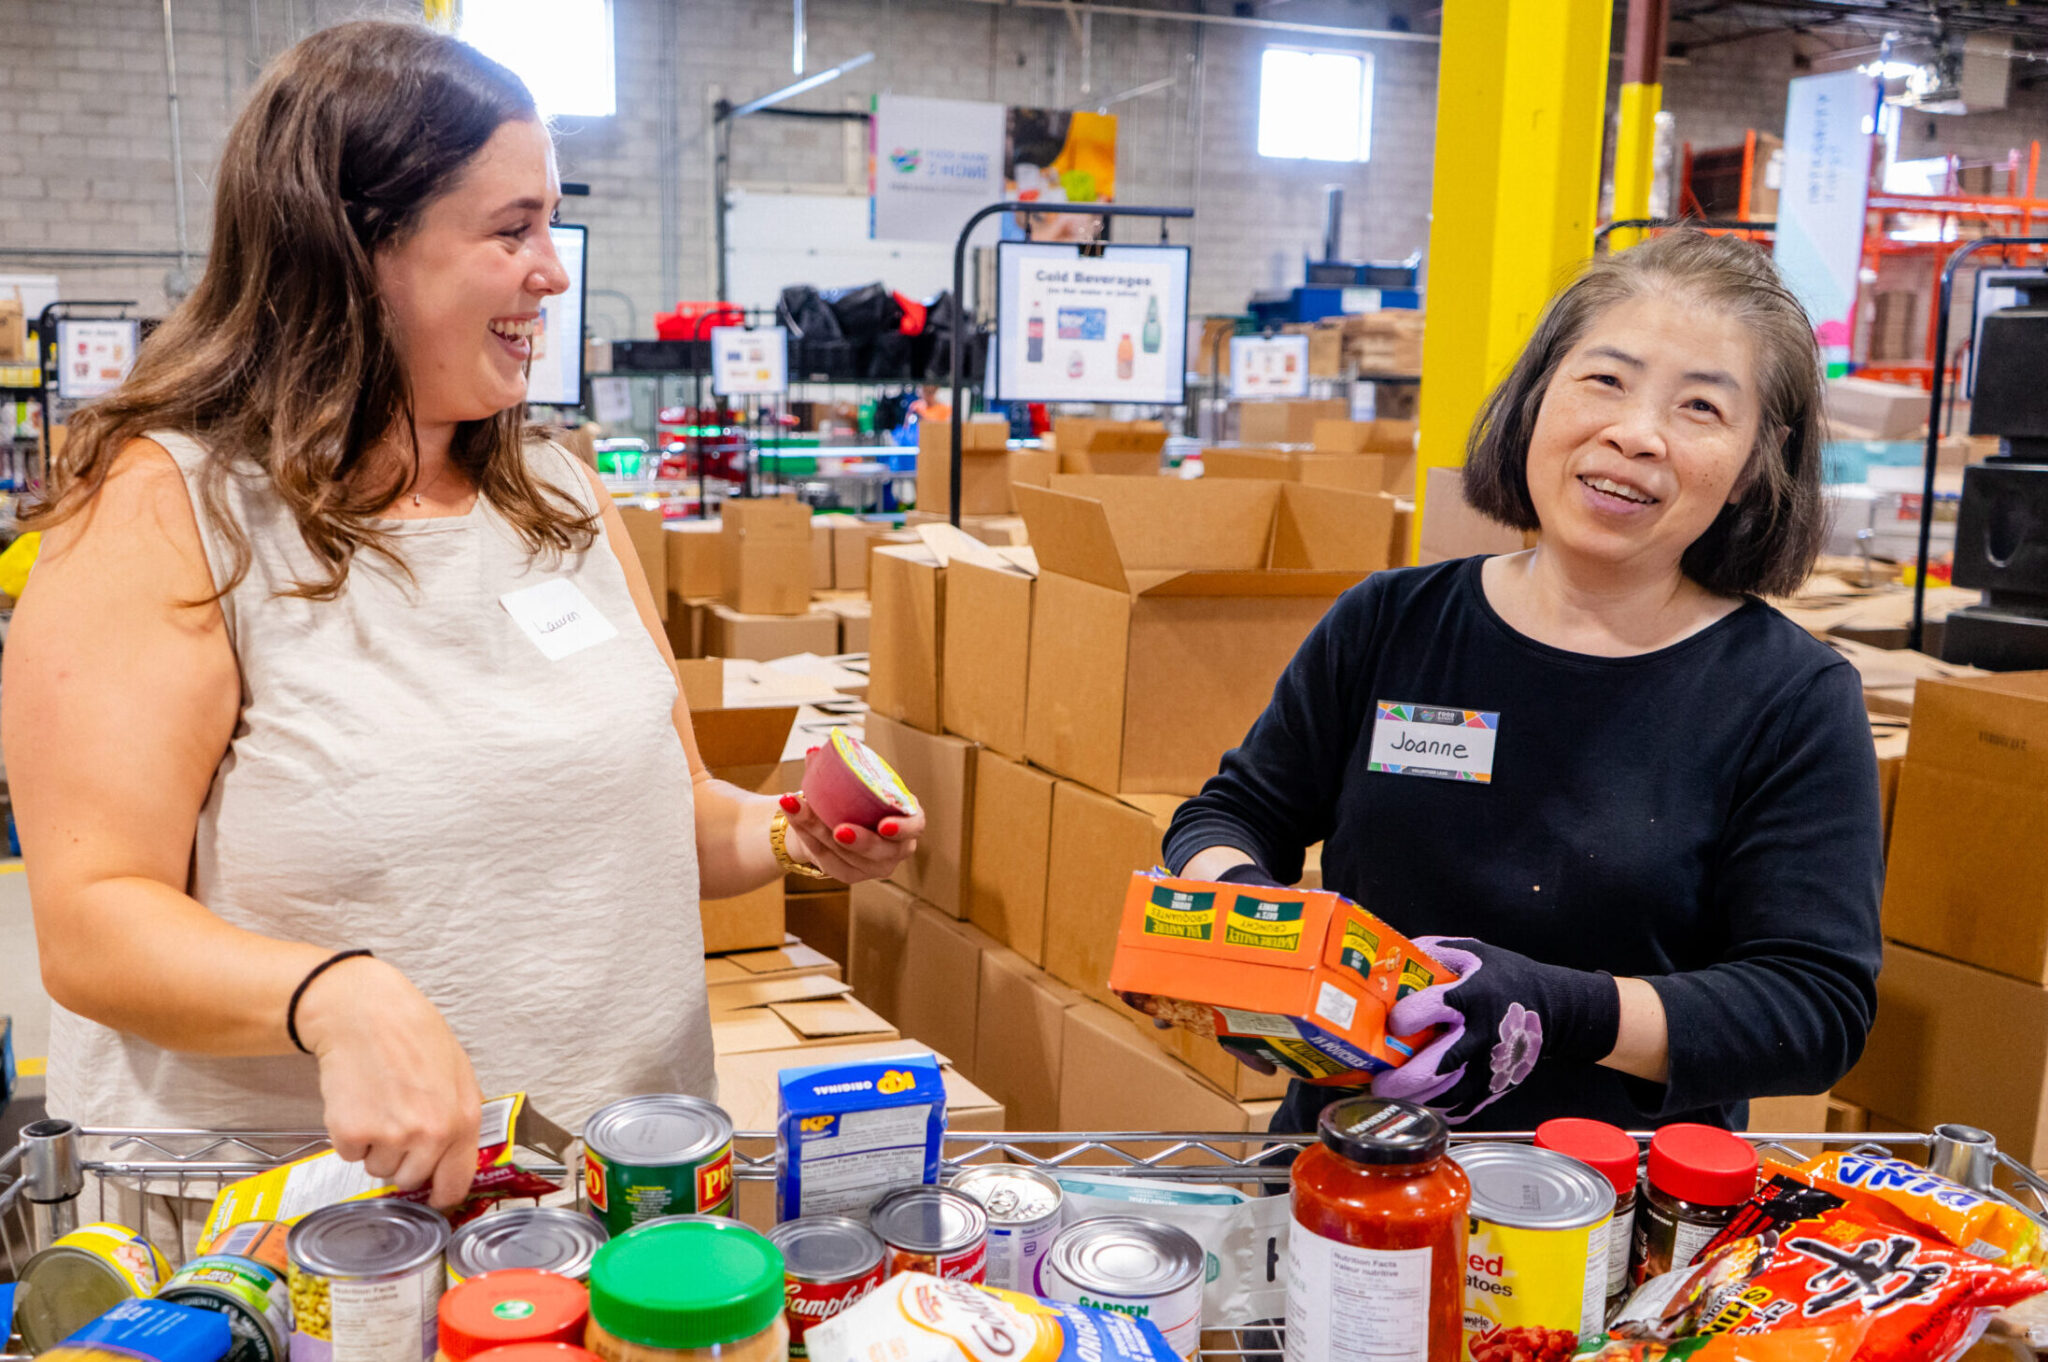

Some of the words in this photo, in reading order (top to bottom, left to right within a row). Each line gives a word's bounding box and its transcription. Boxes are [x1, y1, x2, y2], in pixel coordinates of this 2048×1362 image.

[1036, 270, 1068, 282] Cold
[1074, 272, 1151, 287] Beverages
[1390, 731, 1469, 759] Joanne
[1151, 908, 1208, 924] CROQUANTES
[1240, 920, 1286, 933] CRUNCHY
[1227, 929, 1259, 947] VALLEY
[1260, 935, 1297, 950] NATURE
[813, 1080, 873, 1096] ORIGINAL
[1334, 1252, 1370, 1266] Nutrition
[1373, 1260, 1397, 1268] Facts
[1468, 1254, 1503, 1277] ed
[1334, 1262, 1360, 1273] Valeur
[1362, 1268, 1398, 1277] nutritive
[1701, 1289, 1768, 1336] SHIN
